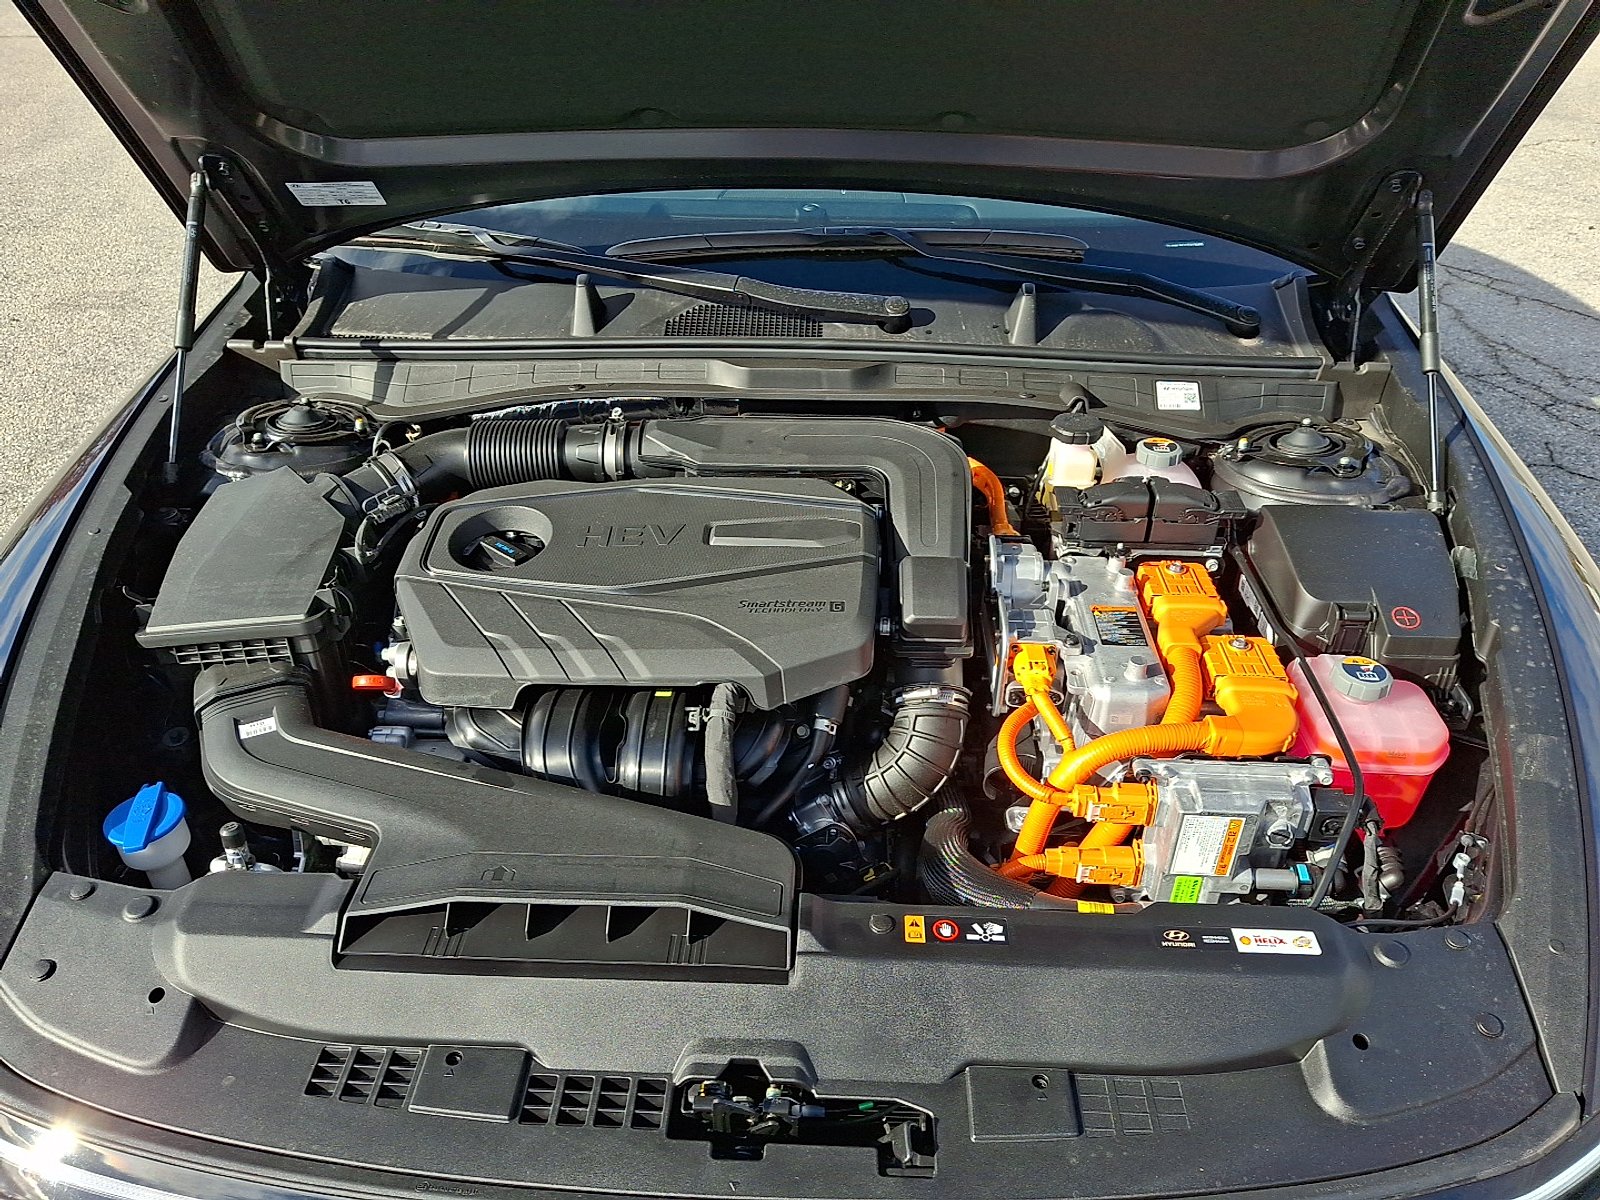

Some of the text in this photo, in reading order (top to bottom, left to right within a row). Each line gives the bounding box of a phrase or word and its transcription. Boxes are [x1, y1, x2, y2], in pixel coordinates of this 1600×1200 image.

[576, 524, 687, 547] HEV
[738, 600, 827, 609] Smartstream
[1161, 940, 1197, 948] HYUNDAI
[1254, 937, 1288, 945] HELIX
